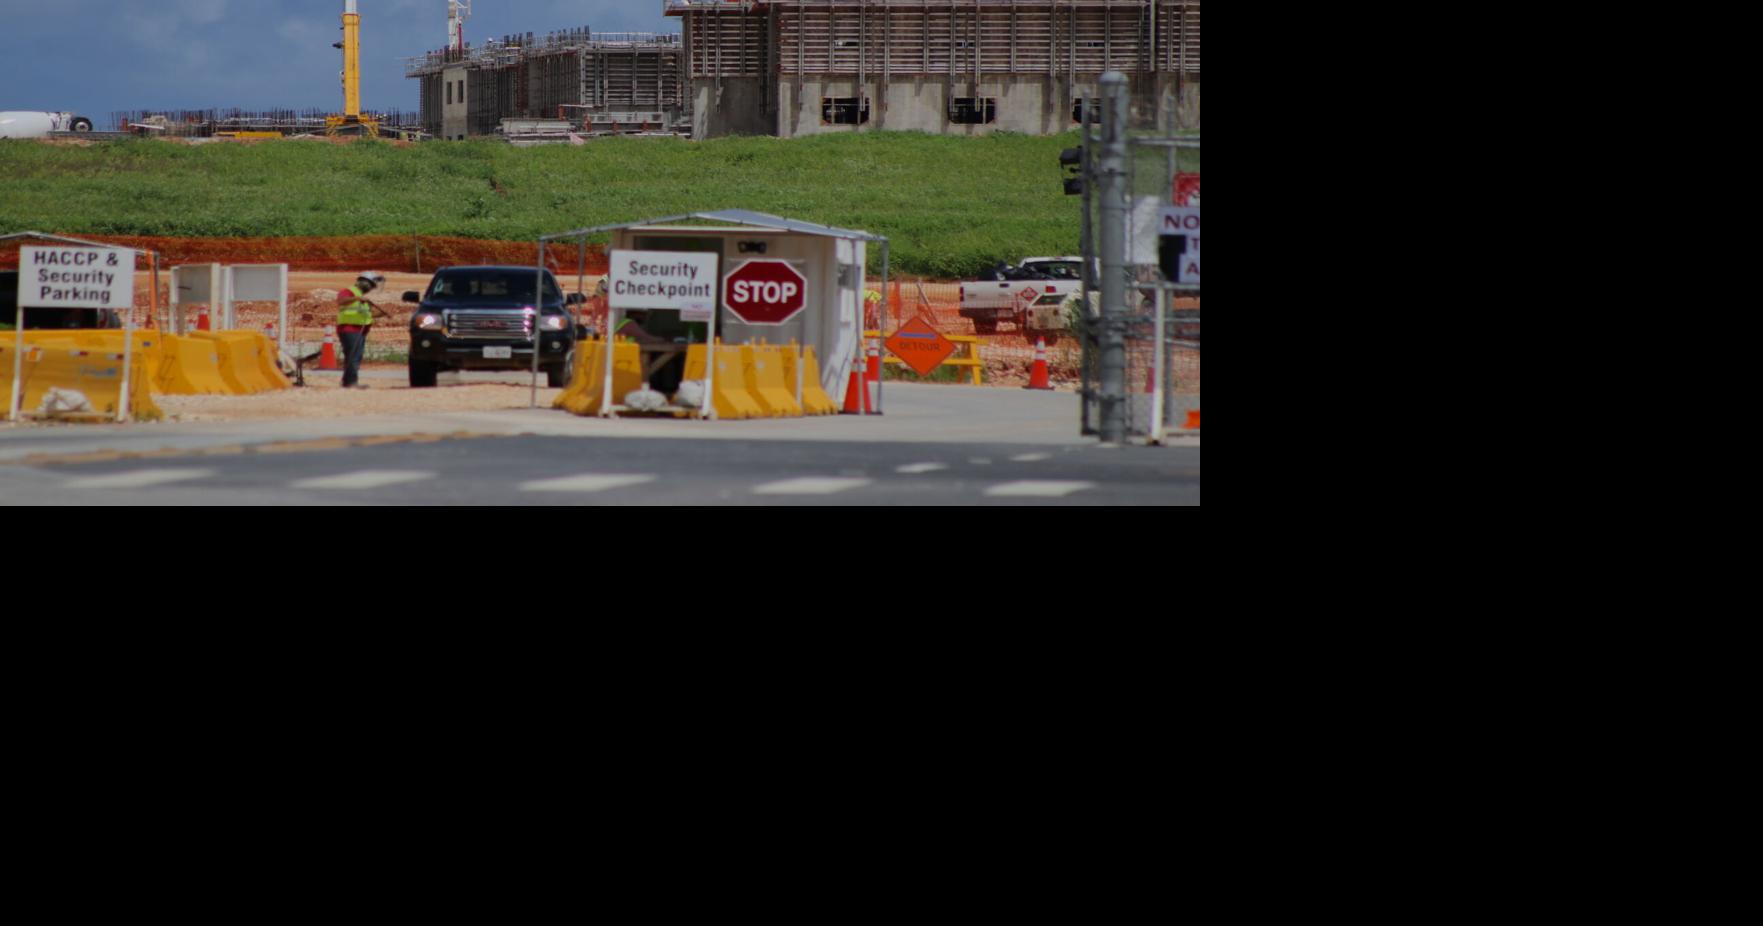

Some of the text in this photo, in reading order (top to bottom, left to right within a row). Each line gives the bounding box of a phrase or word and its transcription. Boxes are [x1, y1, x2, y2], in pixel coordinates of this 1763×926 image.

[34, 251, 118, 266] HACCP &
[38, 268, 114, 286] Security
[629, 260, 699, 279] Security
[40, 286, 110, 304] Parking
[614, 280, 711, 299] Checkpoint
[732, 280, 797, 304] STOP
